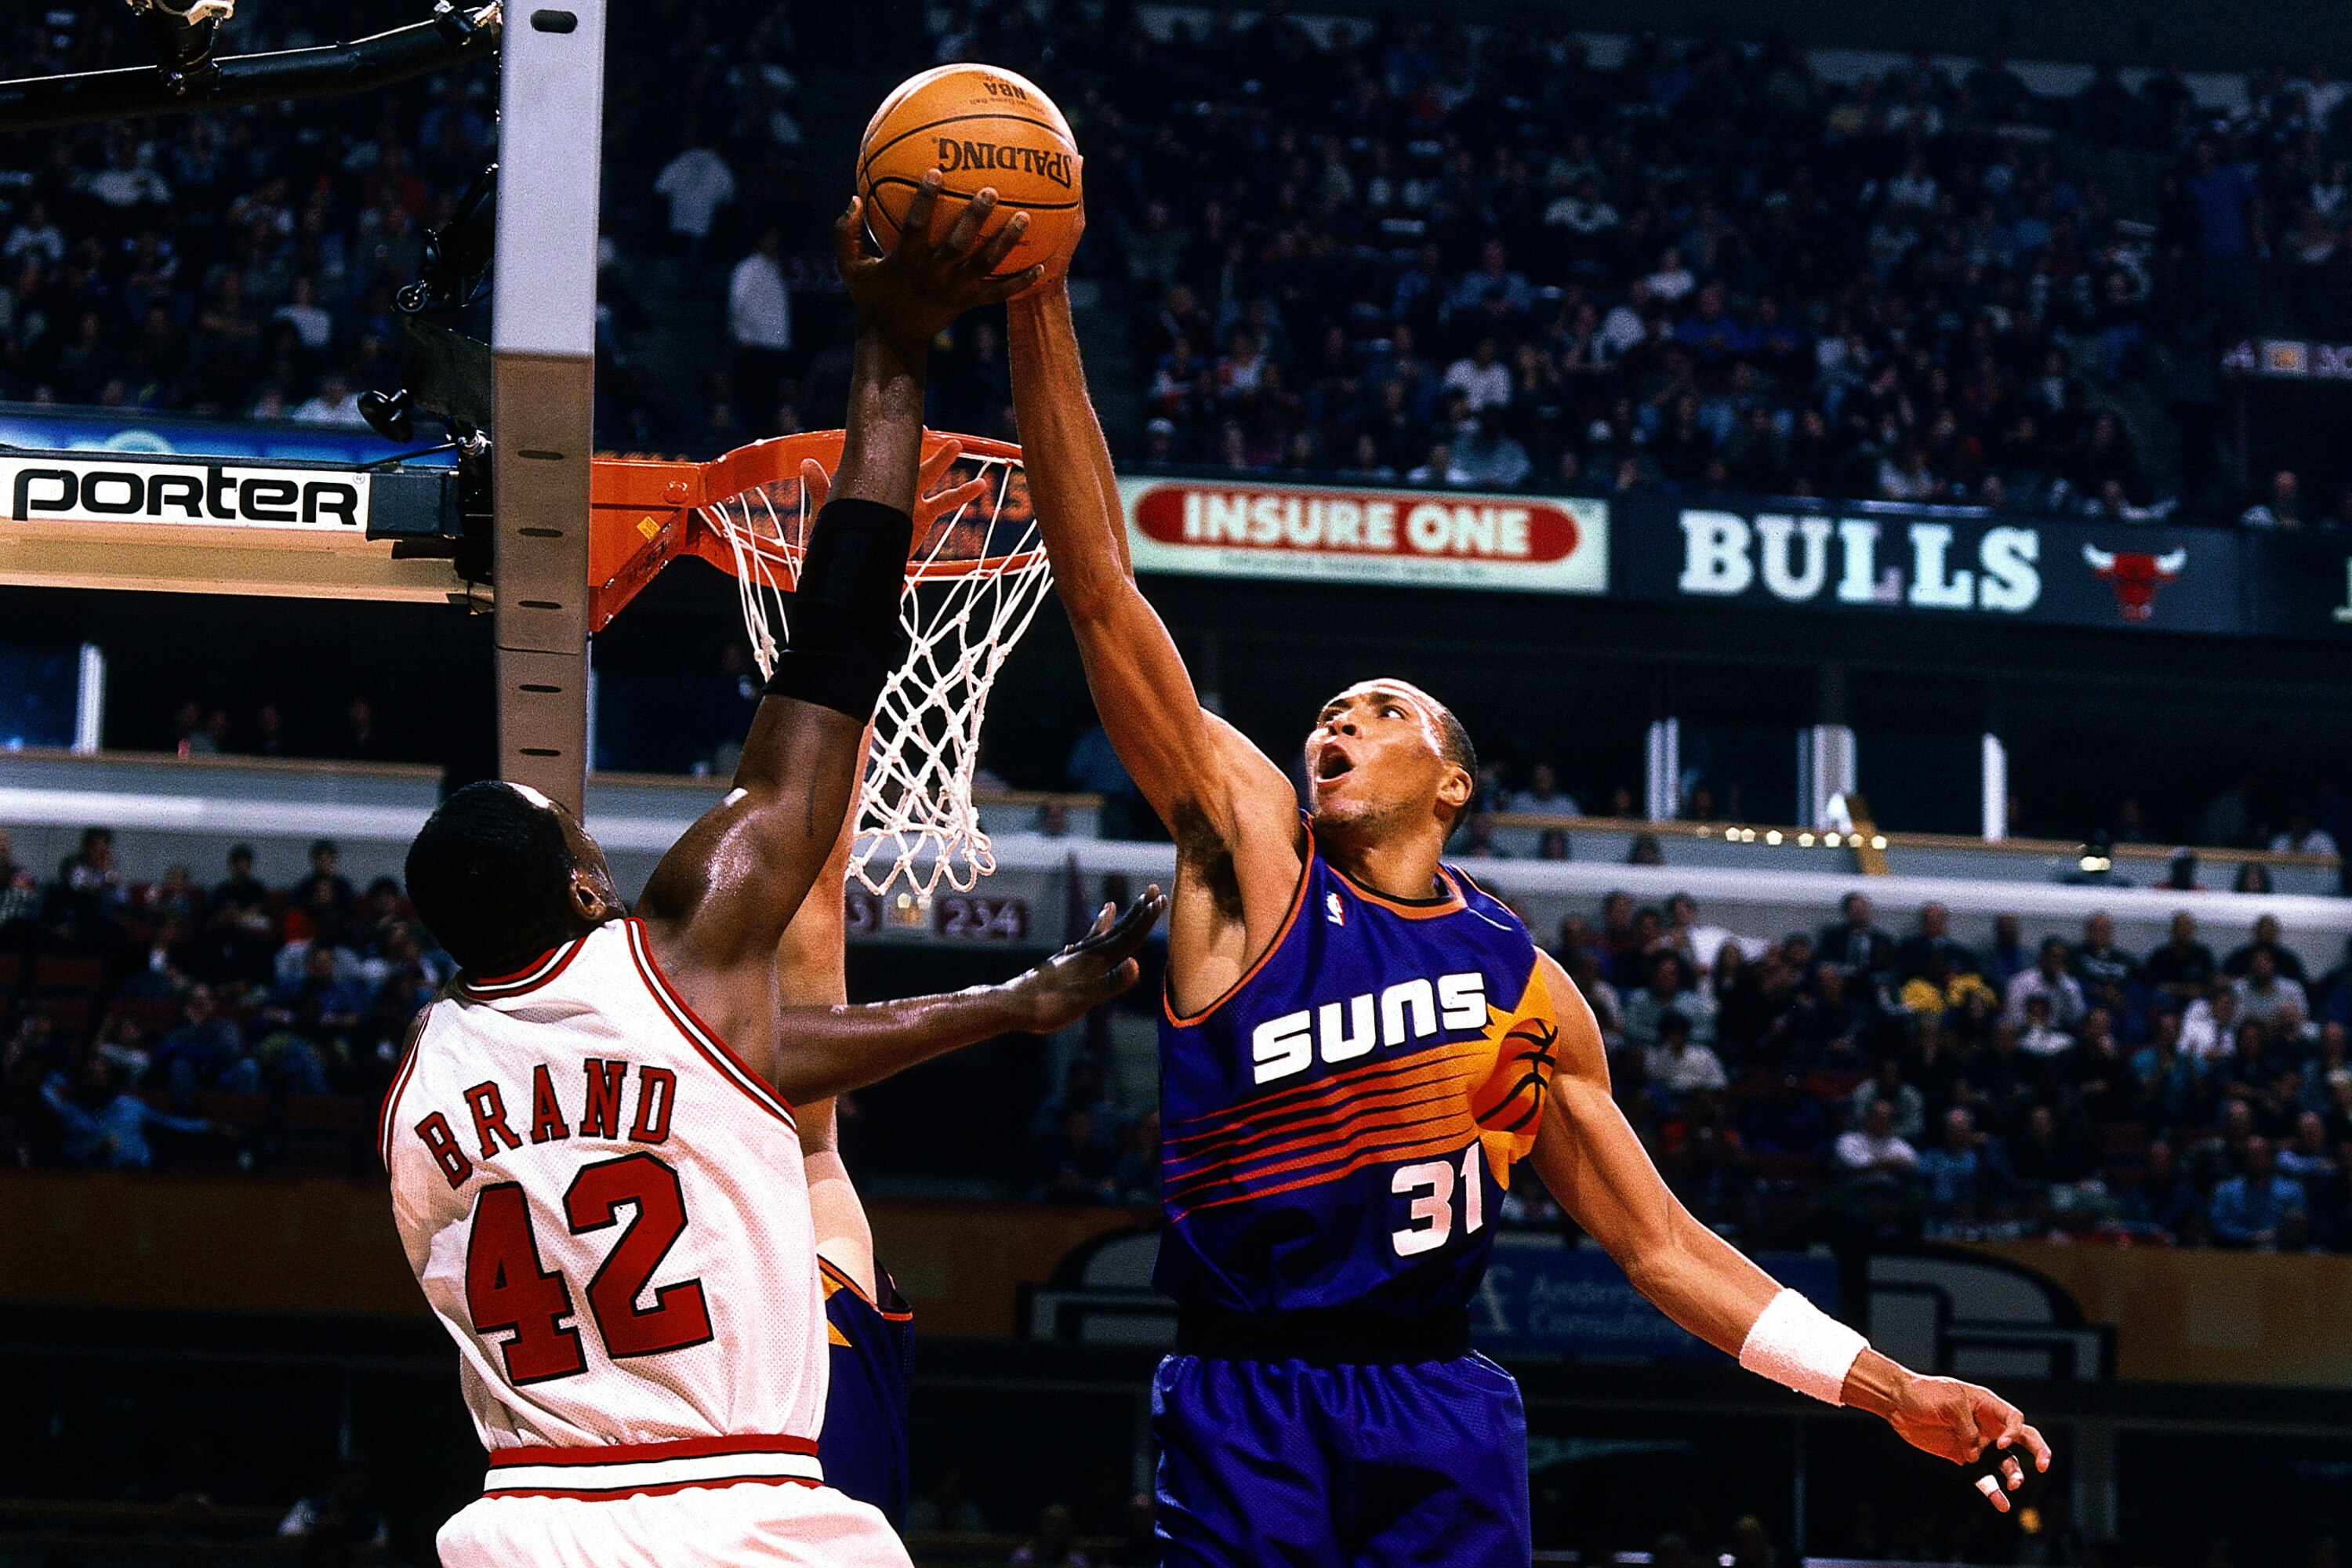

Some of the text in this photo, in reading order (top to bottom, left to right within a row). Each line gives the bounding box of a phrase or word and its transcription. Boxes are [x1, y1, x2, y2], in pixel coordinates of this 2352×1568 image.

[982, 82, 1027, 100] NBA
[938, 137, 1073, 189] SPALDING
[1182, 491, 1530, 556] INSURE ONE
[1678, 509, 2042, 613] BULLS
[943, 898, 1022, 935] 234
[1251, 971, 1489, 1086] SUNS
[414, 1057, 677, 1190] BRAND
[1391, 1140, 1484, 1258] 31
[465, 1151, 714, 1387] 42
